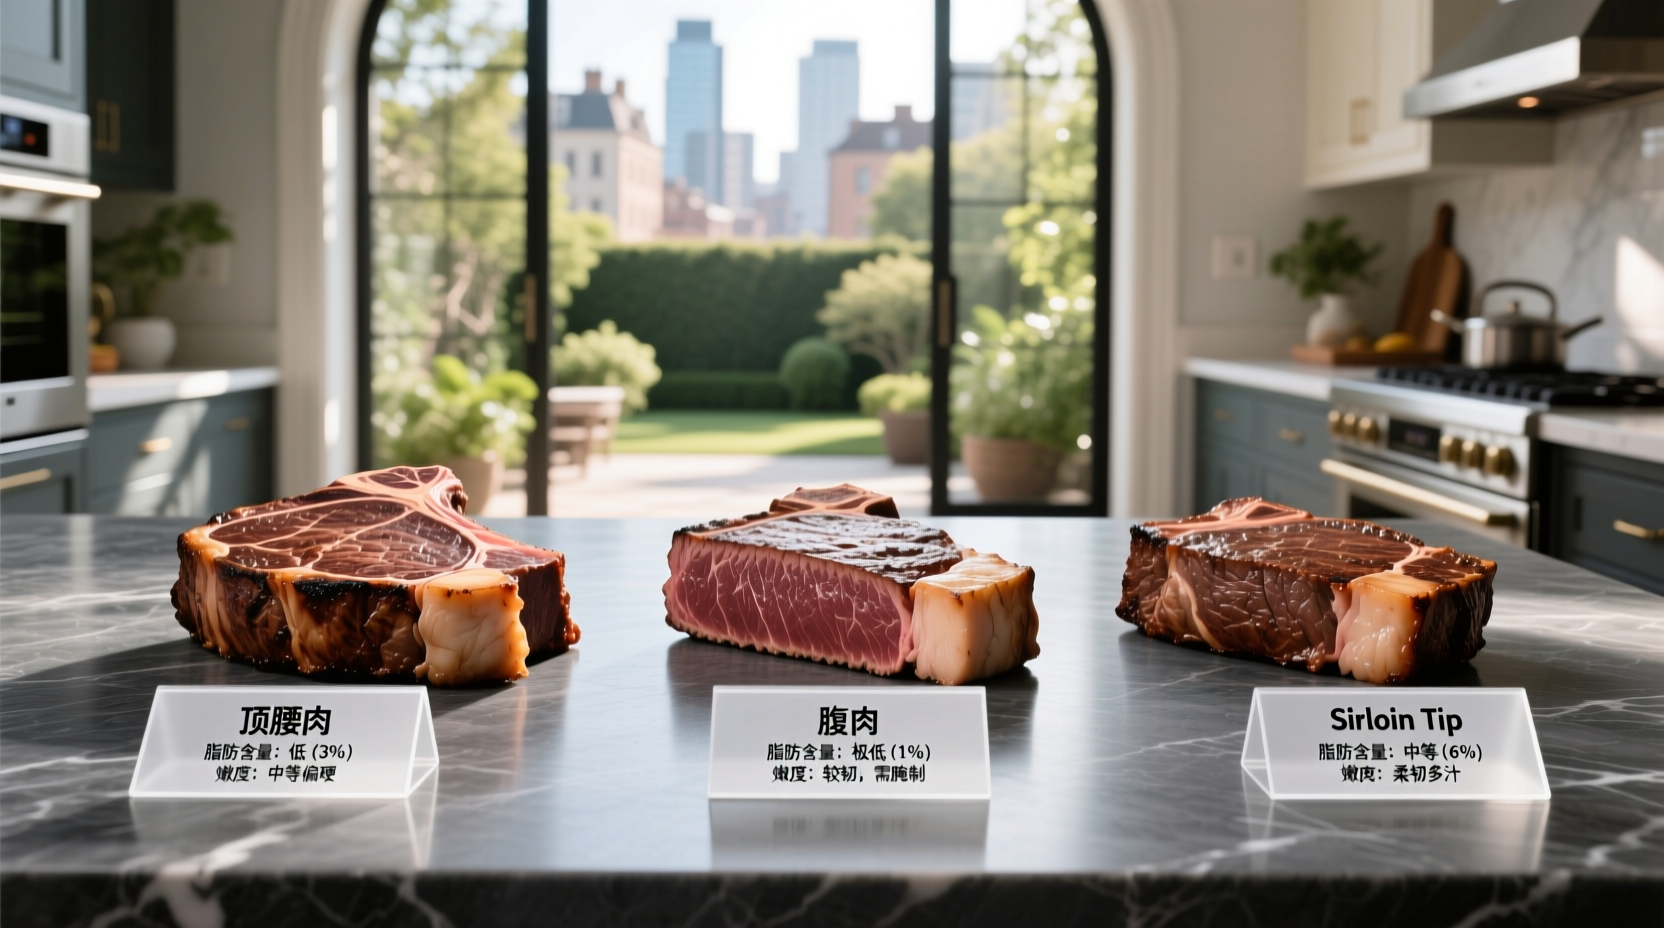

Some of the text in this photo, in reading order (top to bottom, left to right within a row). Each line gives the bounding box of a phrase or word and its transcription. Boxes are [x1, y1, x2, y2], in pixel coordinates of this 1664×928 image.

[239, 705, 332, 737] 顶腰肉
[817, 705, 878, 737] 腹肉
[1330, 707, 1463, 737] Sirloin Tip
